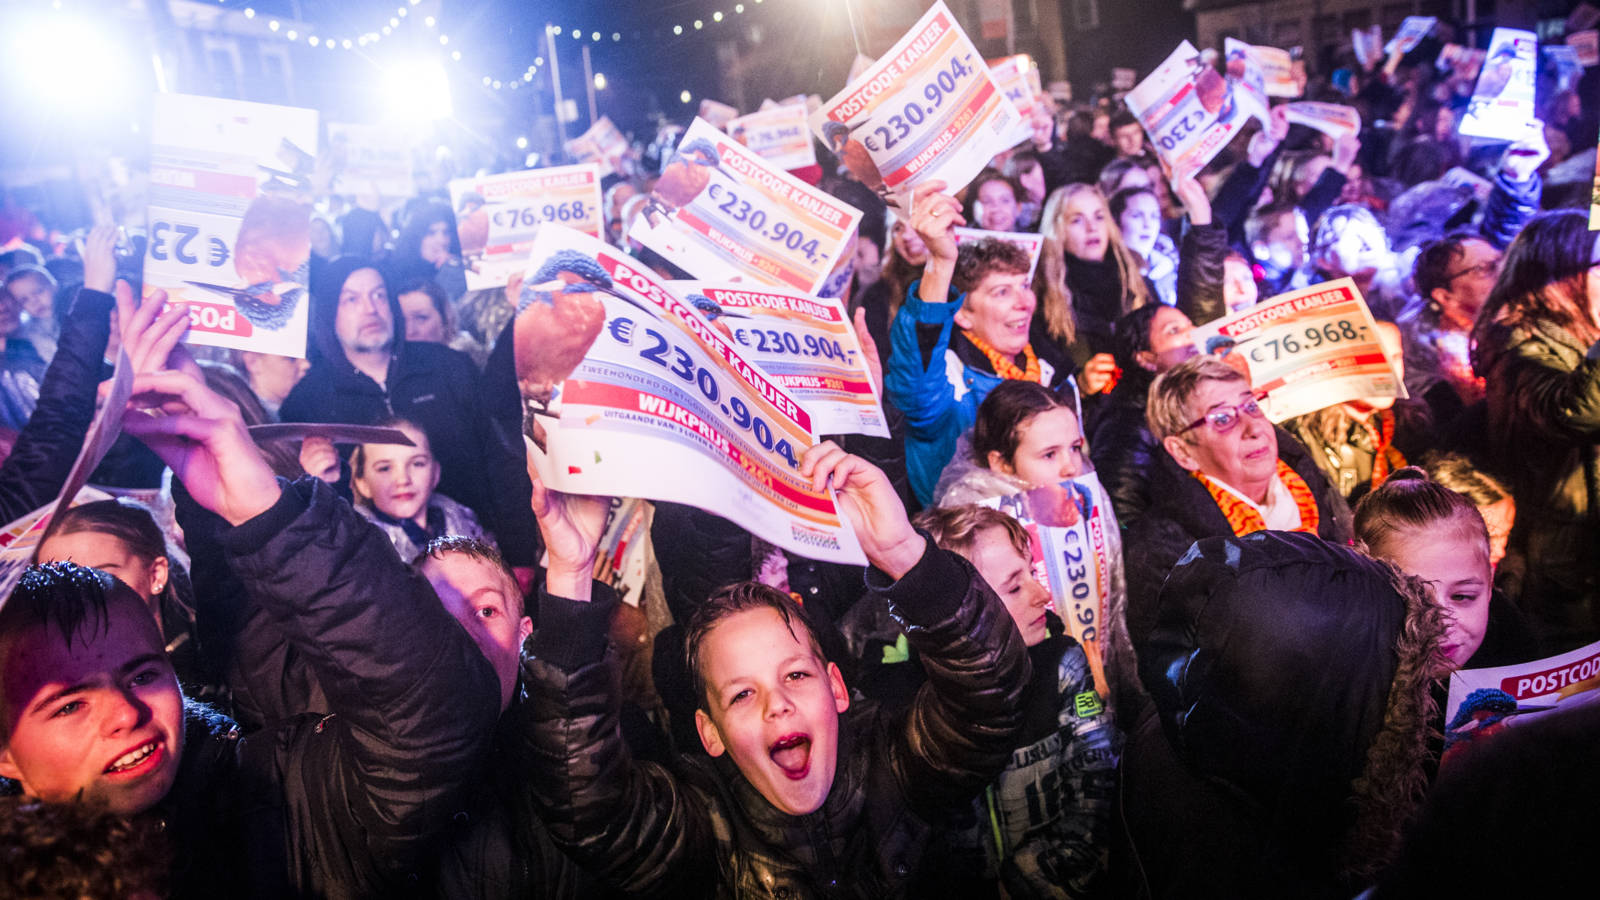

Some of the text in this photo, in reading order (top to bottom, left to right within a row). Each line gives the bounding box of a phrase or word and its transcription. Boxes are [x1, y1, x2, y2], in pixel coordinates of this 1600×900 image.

[834, 21, 943, 122] POSTCODE KANJER
[722, 148, 843, 225] POSTCODE KANJER
[187, 304, 236, 331] POS
[714, 290, 833, 320] POSTCODE KANJER
[1226, 289, 1346, 336] POSTCODE KANJER
[614, 264, 727, 358] POSTCODE
[728, 350, 799, 422] KANJER
[604, 410, 655, 425] UITGAANDE
[639, 393, 730, 454] WIJKPRIJS
